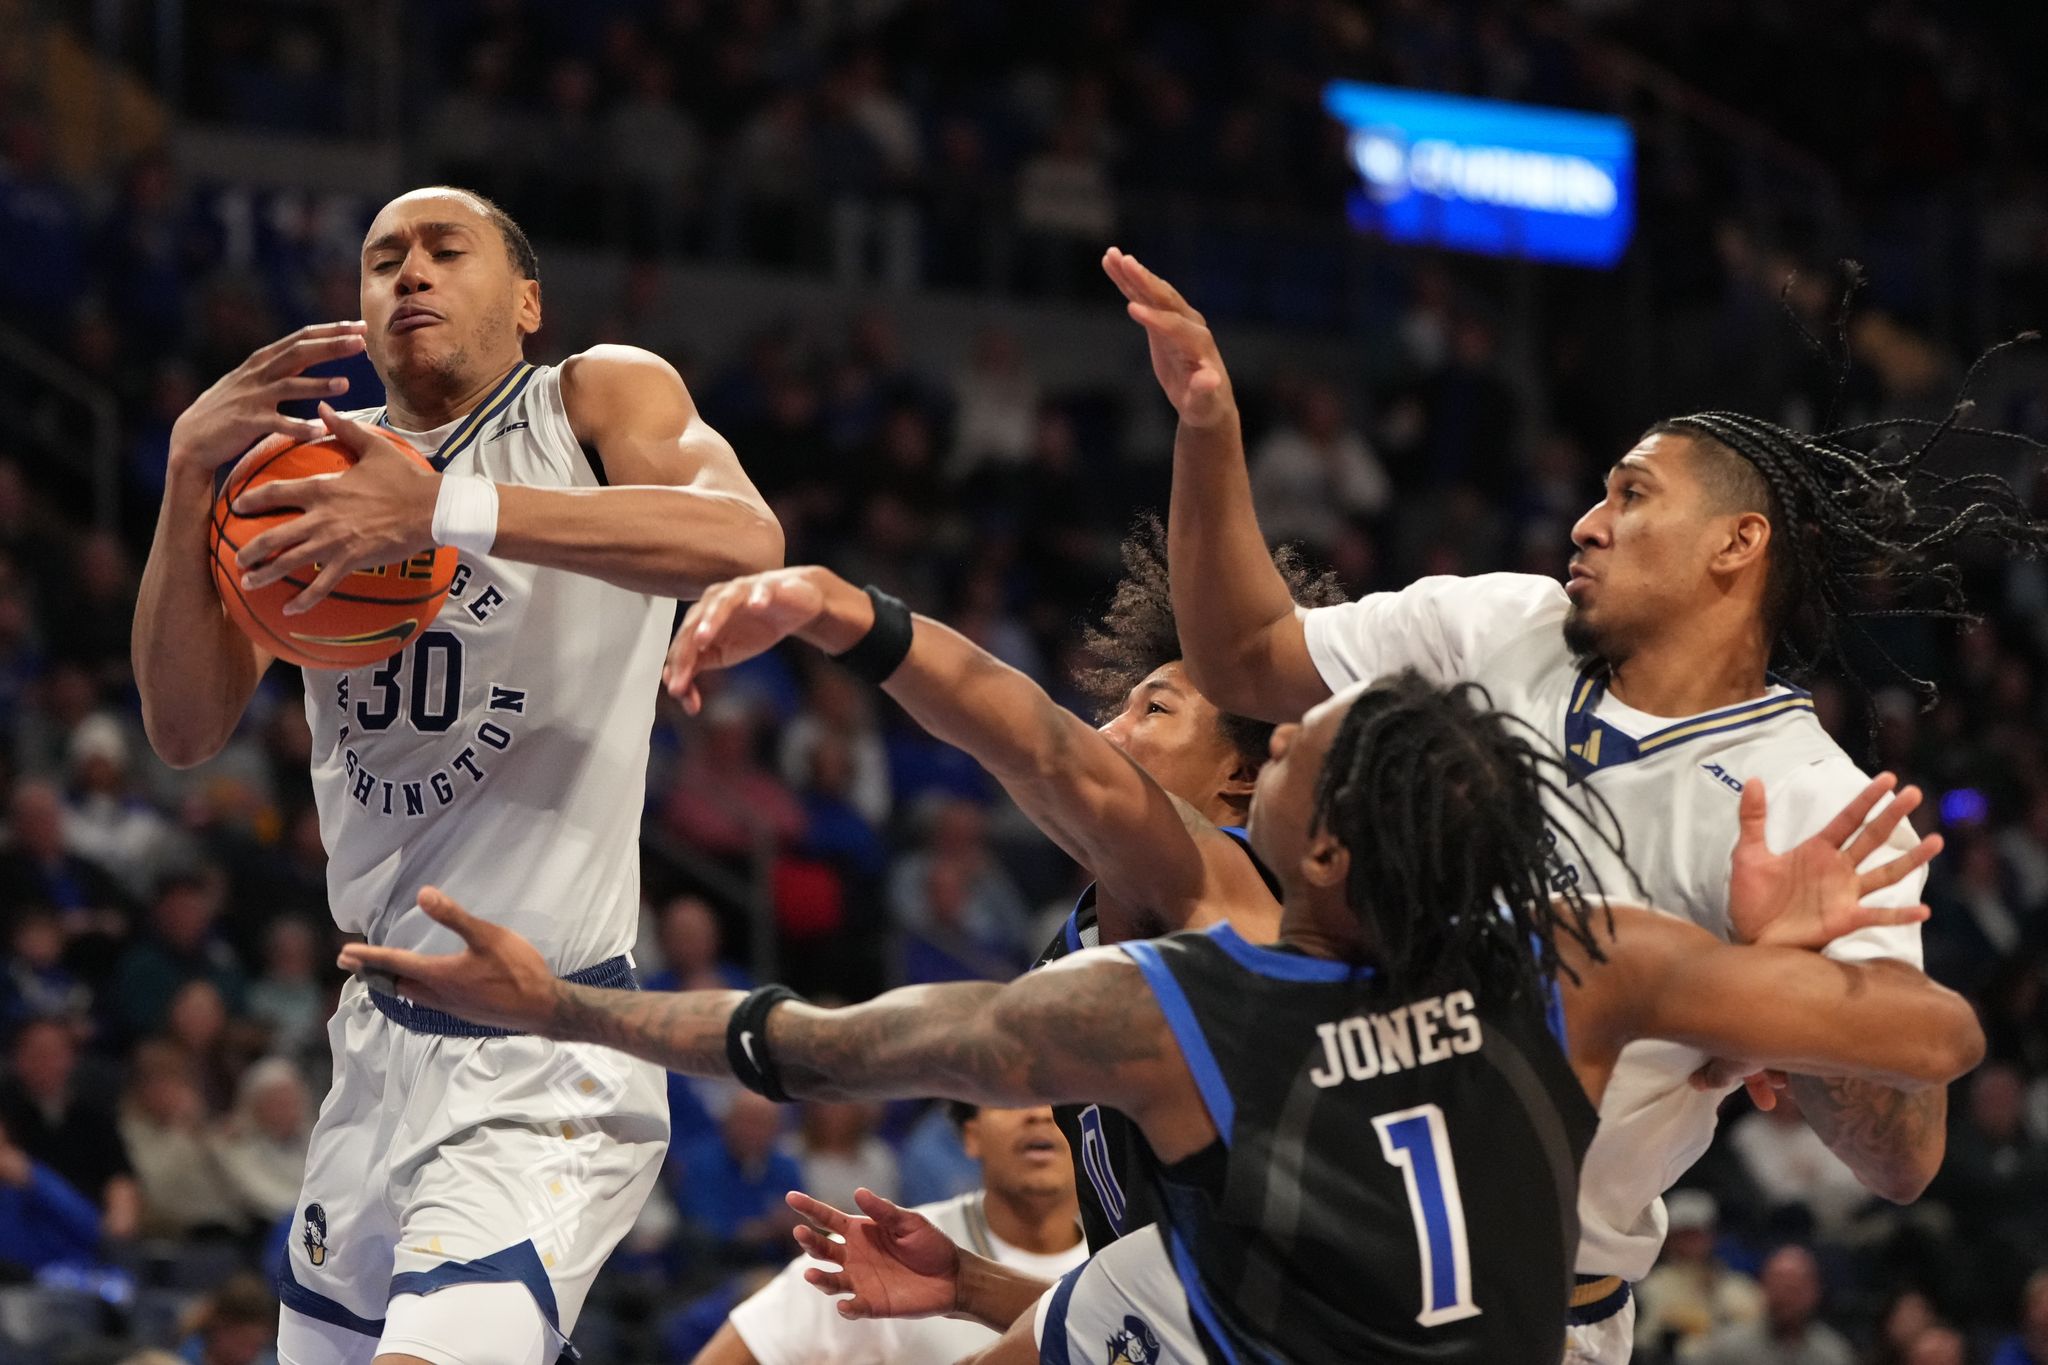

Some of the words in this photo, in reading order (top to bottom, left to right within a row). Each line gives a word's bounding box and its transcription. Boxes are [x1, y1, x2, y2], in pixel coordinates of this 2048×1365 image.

[356, 630, 464, 734] 30
[336, 674, 527, 818] WASHINGTON
[1310, 990, 1483, 1088] JONES
[1371, 1103, 1483, 1328] 1
